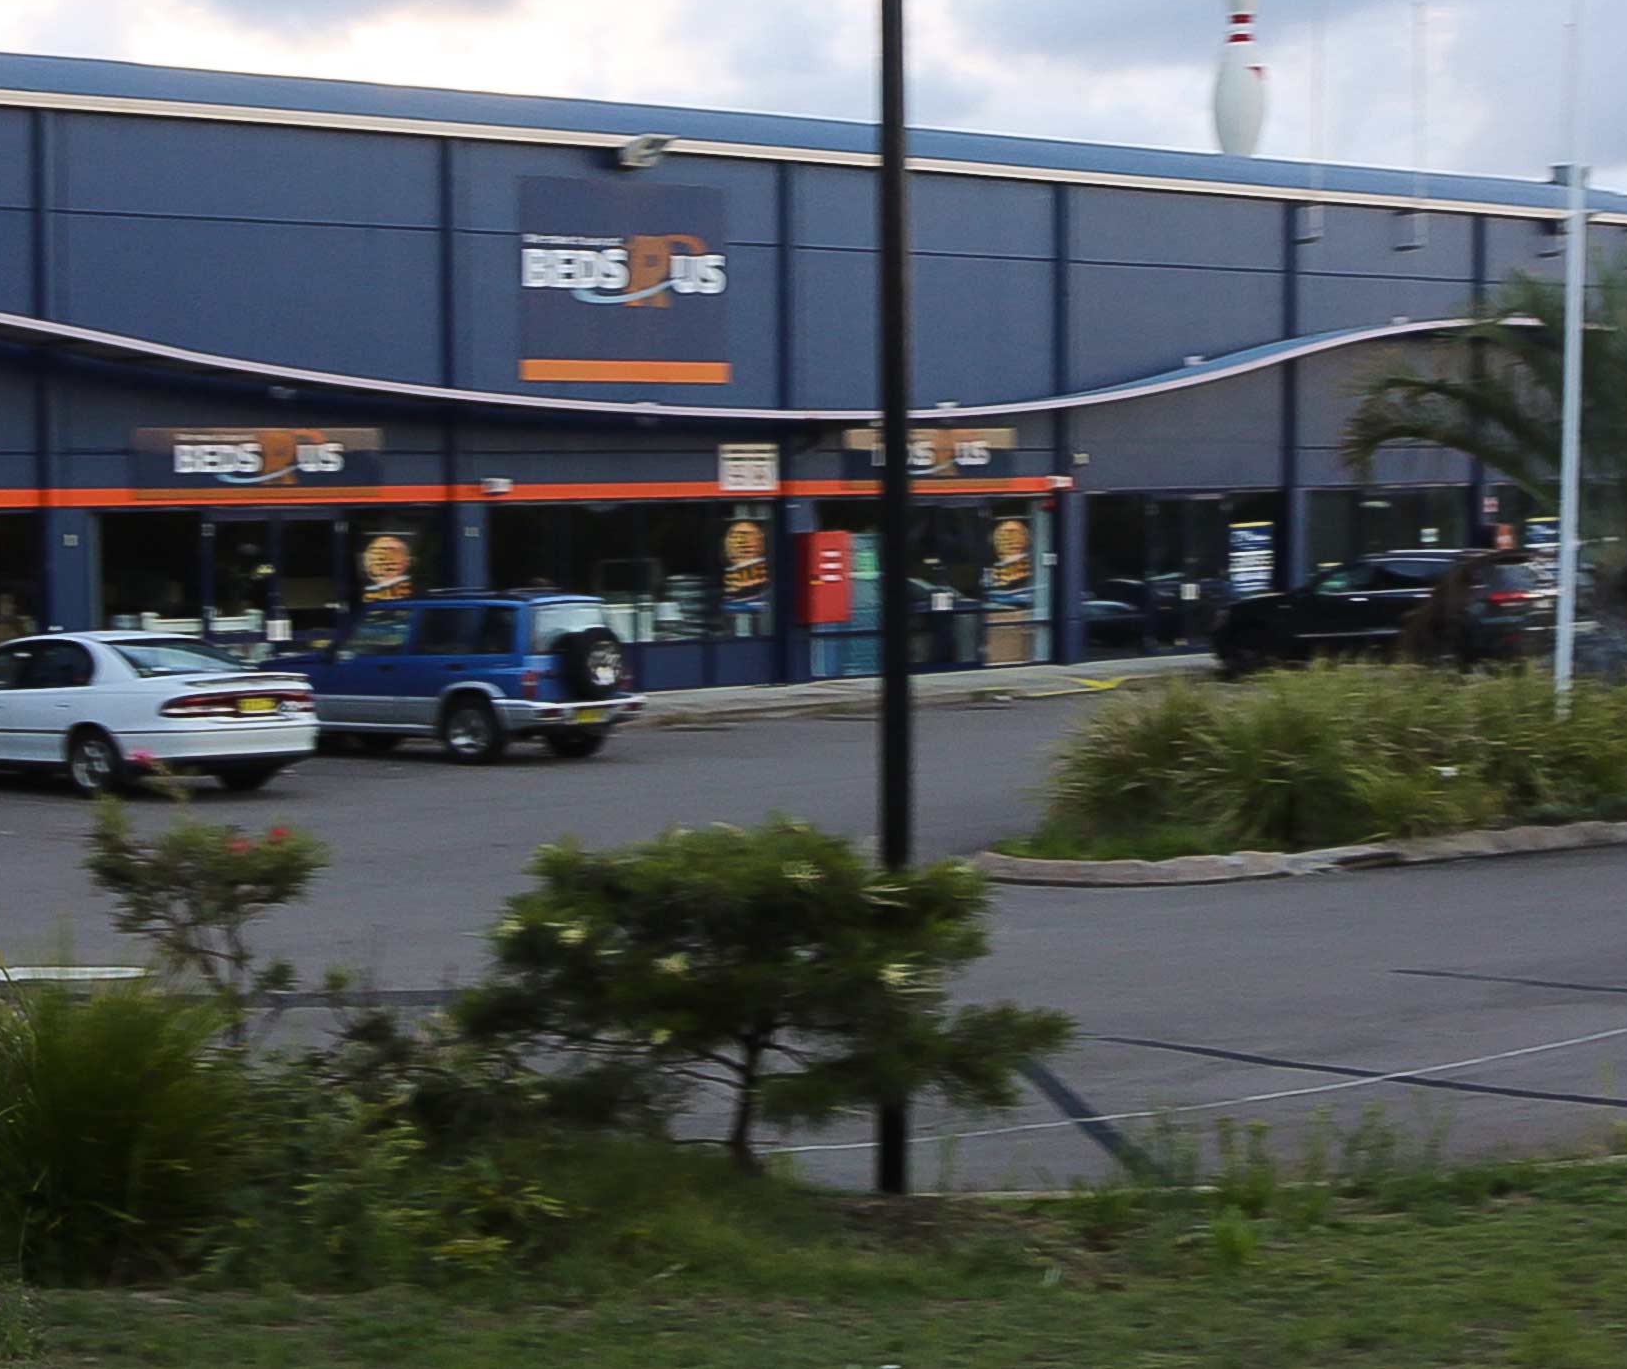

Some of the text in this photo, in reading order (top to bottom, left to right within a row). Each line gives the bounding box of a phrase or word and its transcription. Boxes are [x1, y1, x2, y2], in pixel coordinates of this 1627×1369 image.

[521, 248, 630, 289] BEDS
[670, 254, 727, 294] US
[173, 442, 265, 473] BEDS
[296, 442, 344, 472] US
